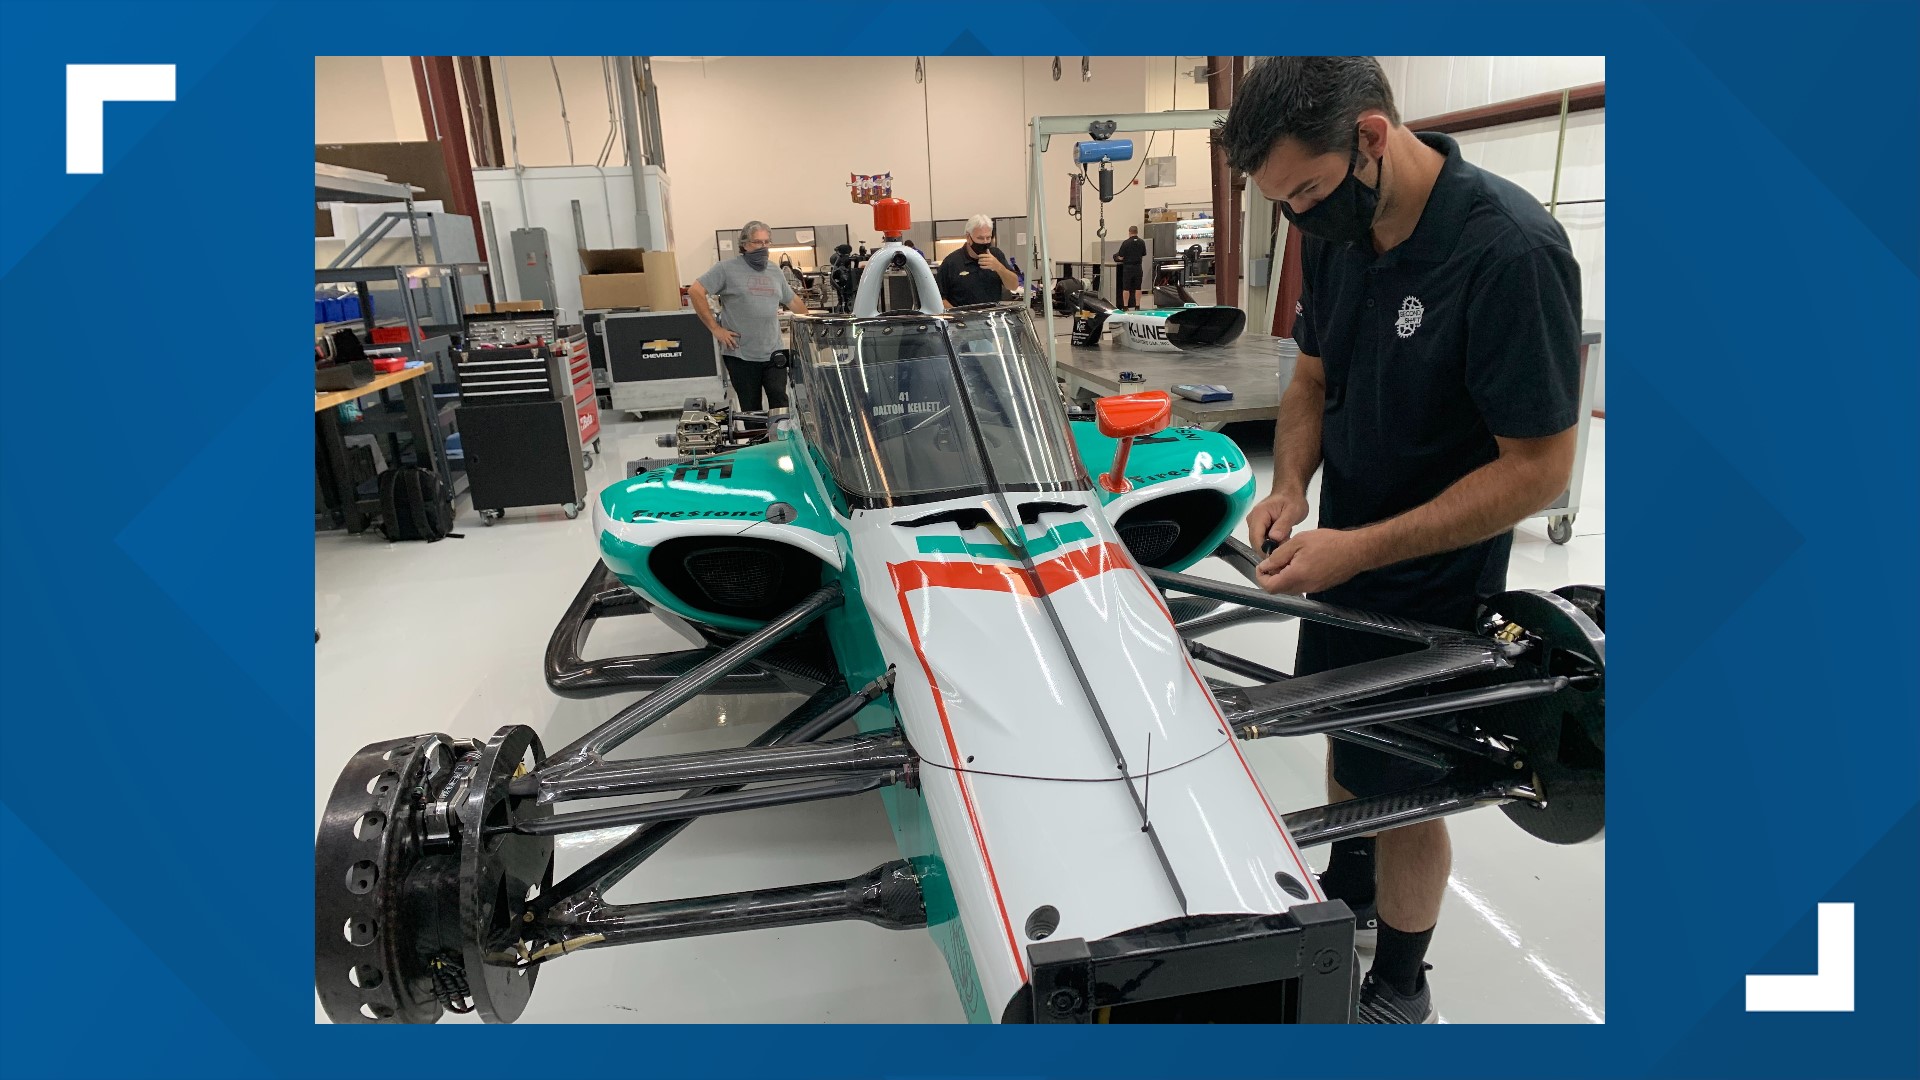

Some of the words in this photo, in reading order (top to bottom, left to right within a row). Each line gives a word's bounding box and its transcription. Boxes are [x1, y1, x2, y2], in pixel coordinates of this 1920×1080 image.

[1399, 310, 1422, 318] SECOND
[642, 351, 683, 360] CHEVROLET
[898, 391, 910, 402] 41
[872, 403, 905, 417] DALTON
[907, 401, 941, 413] KELLETT
[1127, 461, 1237, 484] Firesne
[631, 509, 763, 523] Firestone
